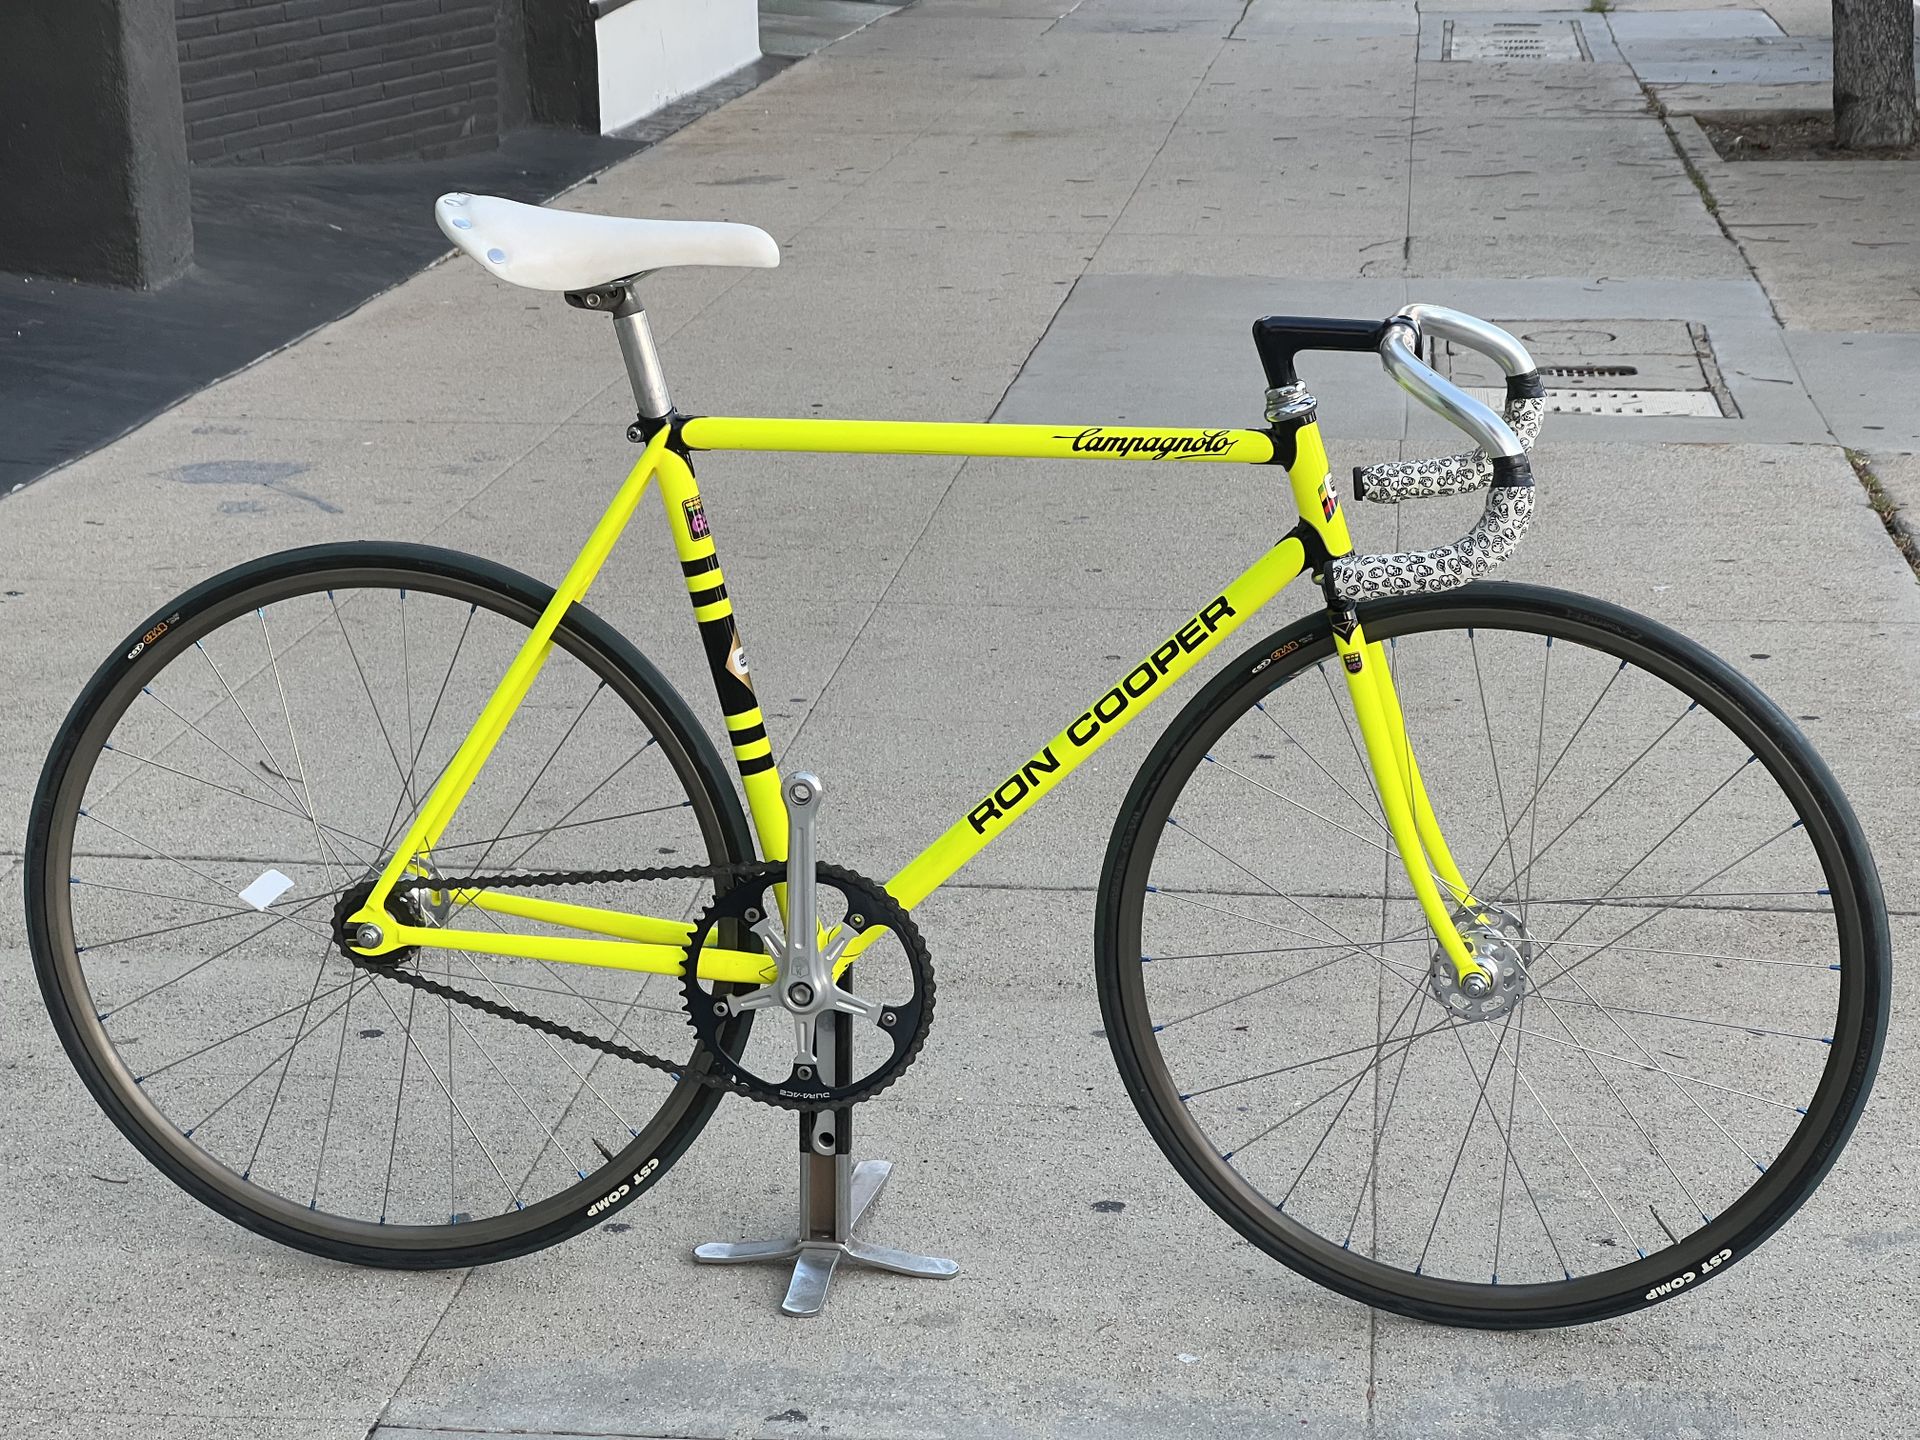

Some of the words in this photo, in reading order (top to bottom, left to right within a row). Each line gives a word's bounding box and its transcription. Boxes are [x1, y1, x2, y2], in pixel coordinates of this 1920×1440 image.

[1052, 428, 1239, 460] Campagnolo
[967, 746, 1061, 834] RON
[1066, 595, 1237, 747] COOPER
[633, 1158, 659, 1185] CST
[587, 1184, 630, 1217] COMP
[1701, 1248, 1733, 1274] CST
[1645, 1271, 1696, 1300] COMP
